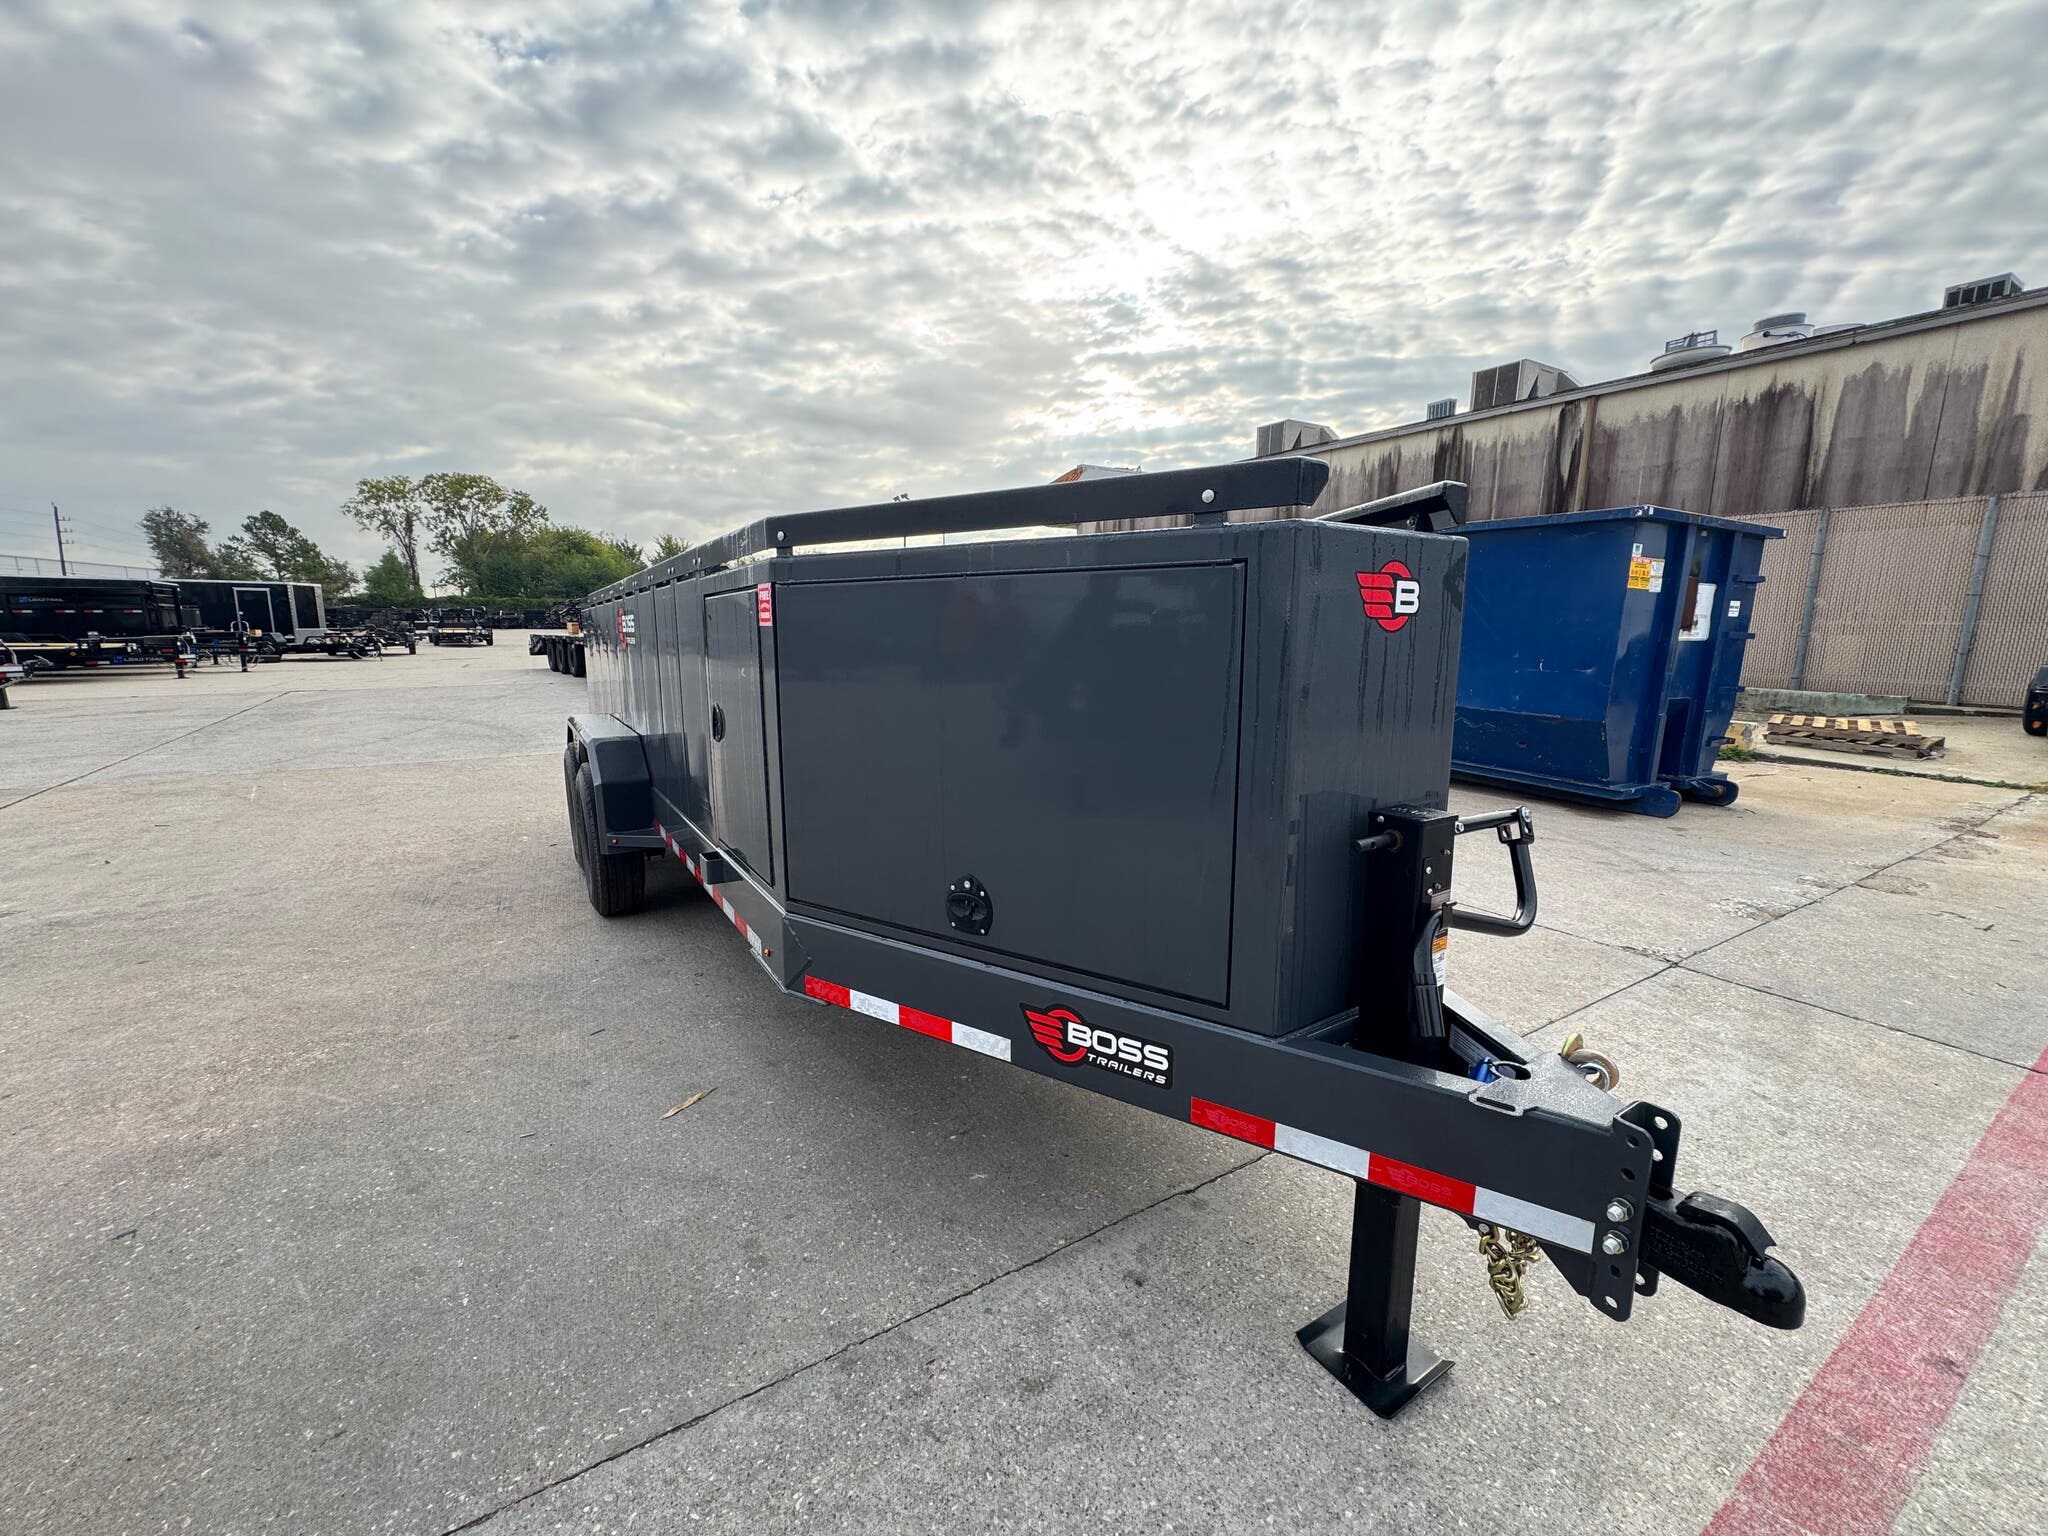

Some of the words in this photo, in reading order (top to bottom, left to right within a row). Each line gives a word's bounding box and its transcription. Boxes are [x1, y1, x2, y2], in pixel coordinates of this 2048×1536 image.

[1394, 580, 1420, 614] B
[1067, 1021, 1169, 1071] BOSS
[1087, 1053, 1167, 1085] TRAILERS
